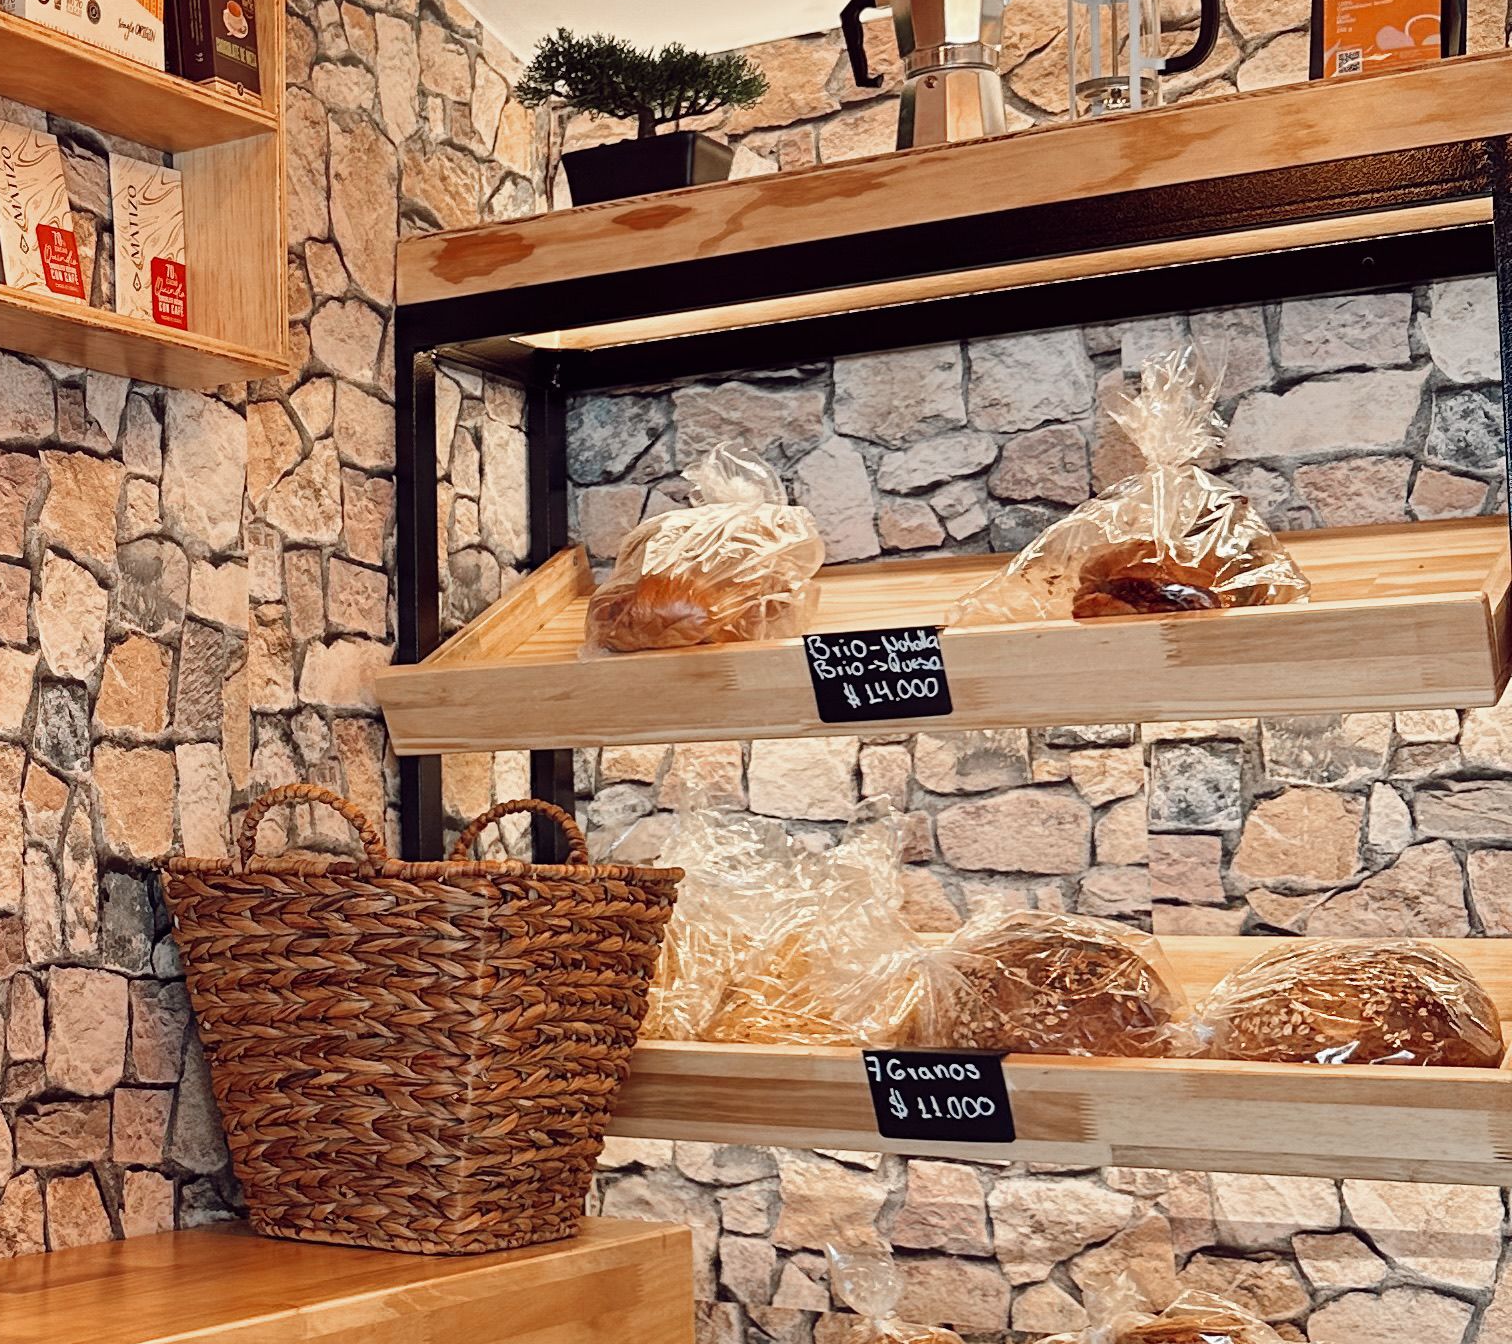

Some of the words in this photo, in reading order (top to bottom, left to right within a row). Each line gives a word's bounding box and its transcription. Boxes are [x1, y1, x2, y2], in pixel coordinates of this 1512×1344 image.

[0, 145, 22, 221] MATIZO
[127, 184, 140, 258] MATIZO
[865, 677, 939, 705] 14.000
[865, 1056, 882, 1082] 7
[886, 1058, 981, 1081] Granos
[888, 1087, 908, 1120] $
[917, 1095, 996, 1120] 11.000
